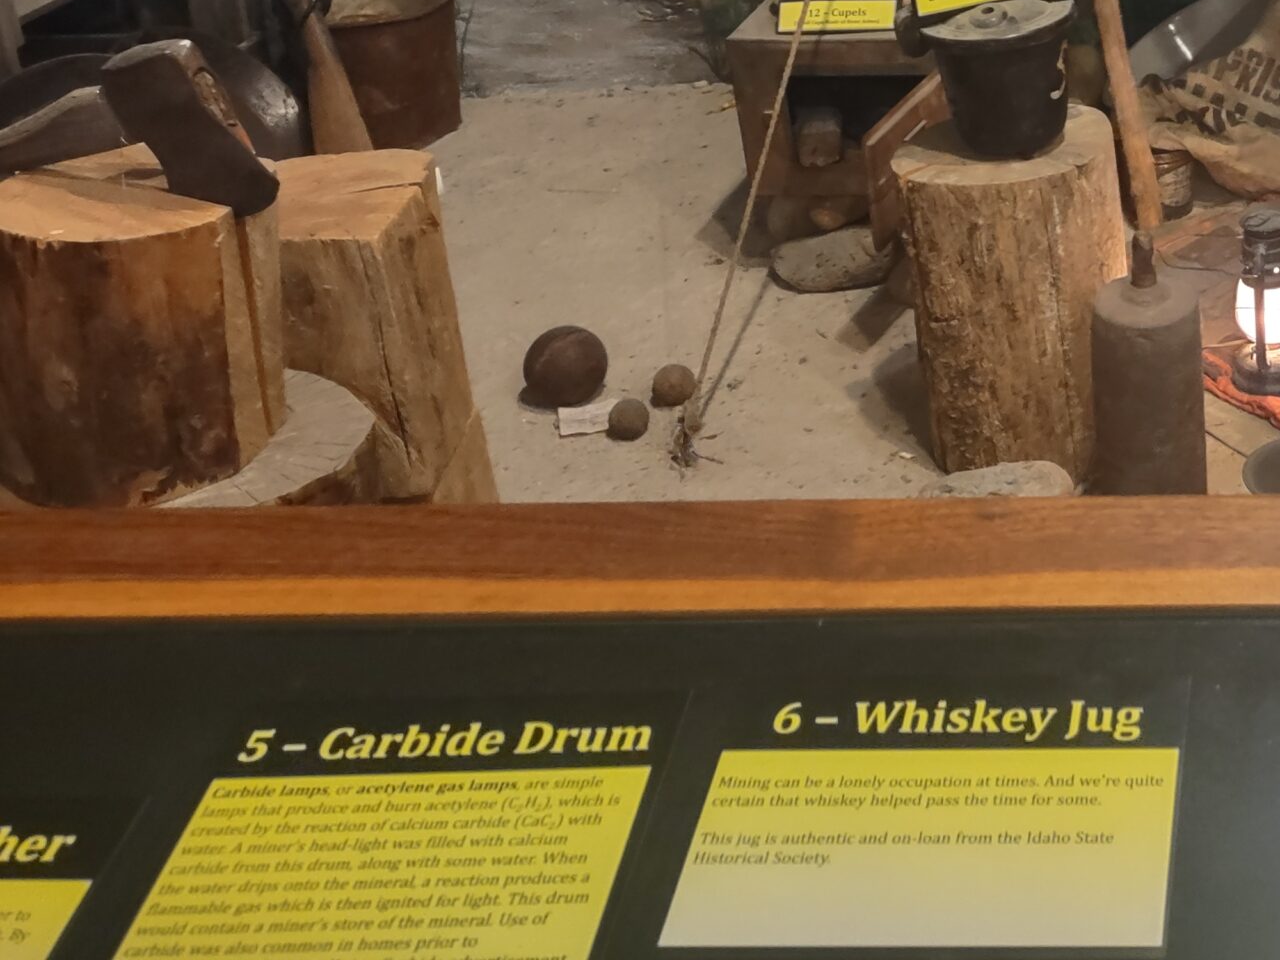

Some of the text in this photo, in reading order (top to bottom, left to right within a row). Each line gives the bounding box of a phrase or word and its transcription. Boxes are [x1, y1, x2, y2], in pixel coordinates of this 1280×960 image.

[808, 8, 821, 18] 12
[831, 8, 868, 19] Cupels
[772, 701, 802, 735] 6
[855, 699, 1057, 742] Whiskey
[1064, 699, 1145, 741] Jug
[236, 728, 276, 763] 5
[318, 721, 506, 761] Carbide
[513, 720, 653, 755] Drum
[211, 787, 276, 799] Carbide
[335, 787, 353, 795] or
[355, 782, 434, 796] acetylene
[435, 784, 465, 794] gas
[523, 781, 549, 789] are
[552, 777, 604, 791] simple
[717, 776, 771, 790] Mining
[773, 779, 800, 788] can
[803, 776, 823, 787] be
[825, 779, 835, 787] a
[838, 776, 885, 790] lonely
[888, 776, 972, 790] occupation
[975, 776, 990, 787] at
[1043, 775, 1075, 787] And
[1124, 776, 1164, 789] quite
[199, 806, 249, 819] lamps
[250, 805, 283, 816] that
[282, 803, 350, 817] produce
[350, 802, 383, 813] and
[383, 801, 422, 812] burn
[423, 799, 498, 813] acetylene
[558, 796, 604, 807] which
[606, 796, 620, 806] is
[711, 796, 765, 806] certain
[768, 794, 800, 806] that
[804, 794, 866, 809] whiskey
[869, 794, 922, 809] helped
[924, 797, 959, 808] pass
[963, 794, 988, 805] the
[992, 795, 1027, 805] time
[1030, 794, 1053, 805] for
[189, 824, 251, 835] created
[251, 823, 272, 836] by
[273, 823, 301, 833] the
[302, 822, 367, 833] reaction
[369, 820, 389, 831] of
[388, 819, 449, 831] calcium
[451, 817, 511, 829] carbide
[567, 815, 602, 826] with
[228, 843, 243, 854] A
[307, 839, 388, 854] head-light
[391, 841, 423, 849] was
[424, 837, 467, 849] filled
[469, 836, 504, 847] with
[507, 834, 568, 846] calcium
[700, 831, 1114, 847] This jug is authentic and on-loan from the Idaho State
[692, 851, 770, 864] Historical
